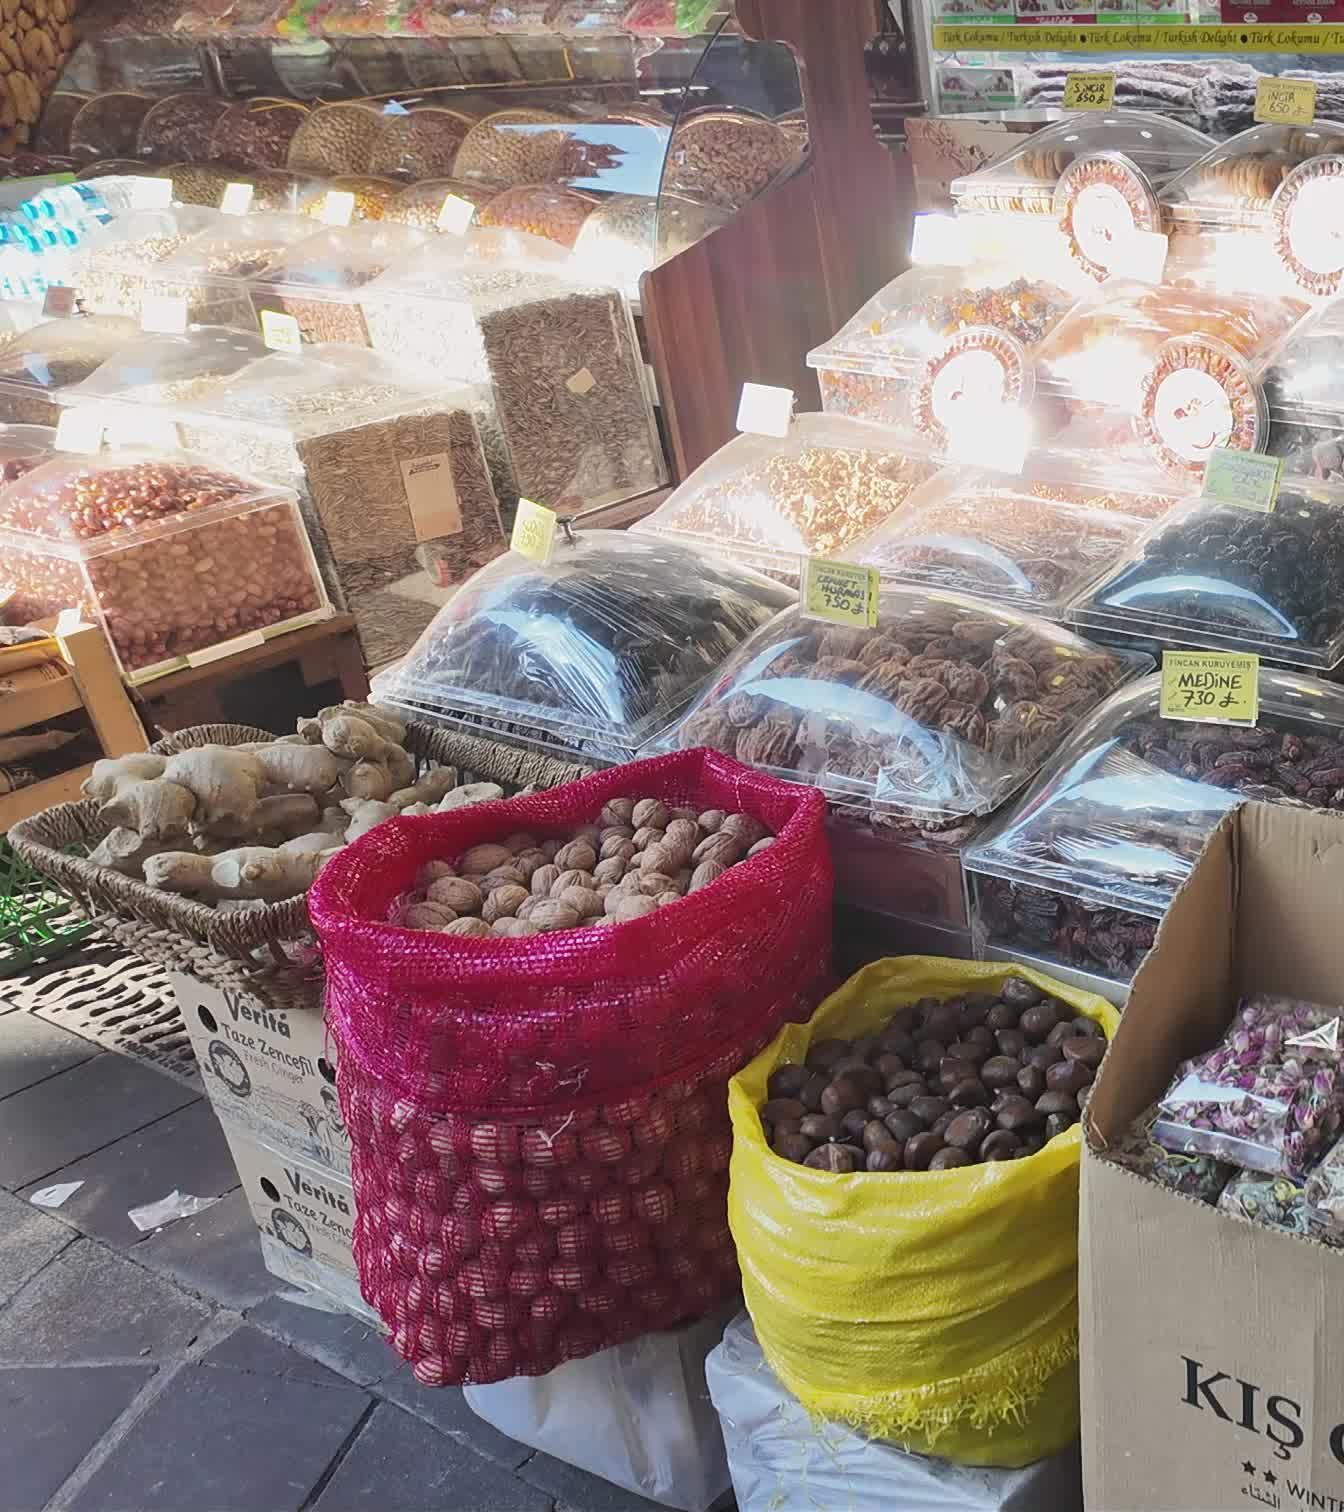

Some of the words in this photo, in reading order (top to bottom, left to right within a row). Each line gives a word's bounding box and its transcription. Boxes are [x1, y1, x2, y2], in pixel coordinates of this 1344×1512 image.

[1250, 30, 1273, 44] Türk
[1277, 30, 1320, 45] Lokumu
[1180, 689, 1216, 708] 730
[220, 1021, 256, 1050] Taze
[282, 1193, 318, 1221] Taze
[319, 1211, 353, 1240] Zenc
[1180, 1354, 1305, 1461] KIŞ
